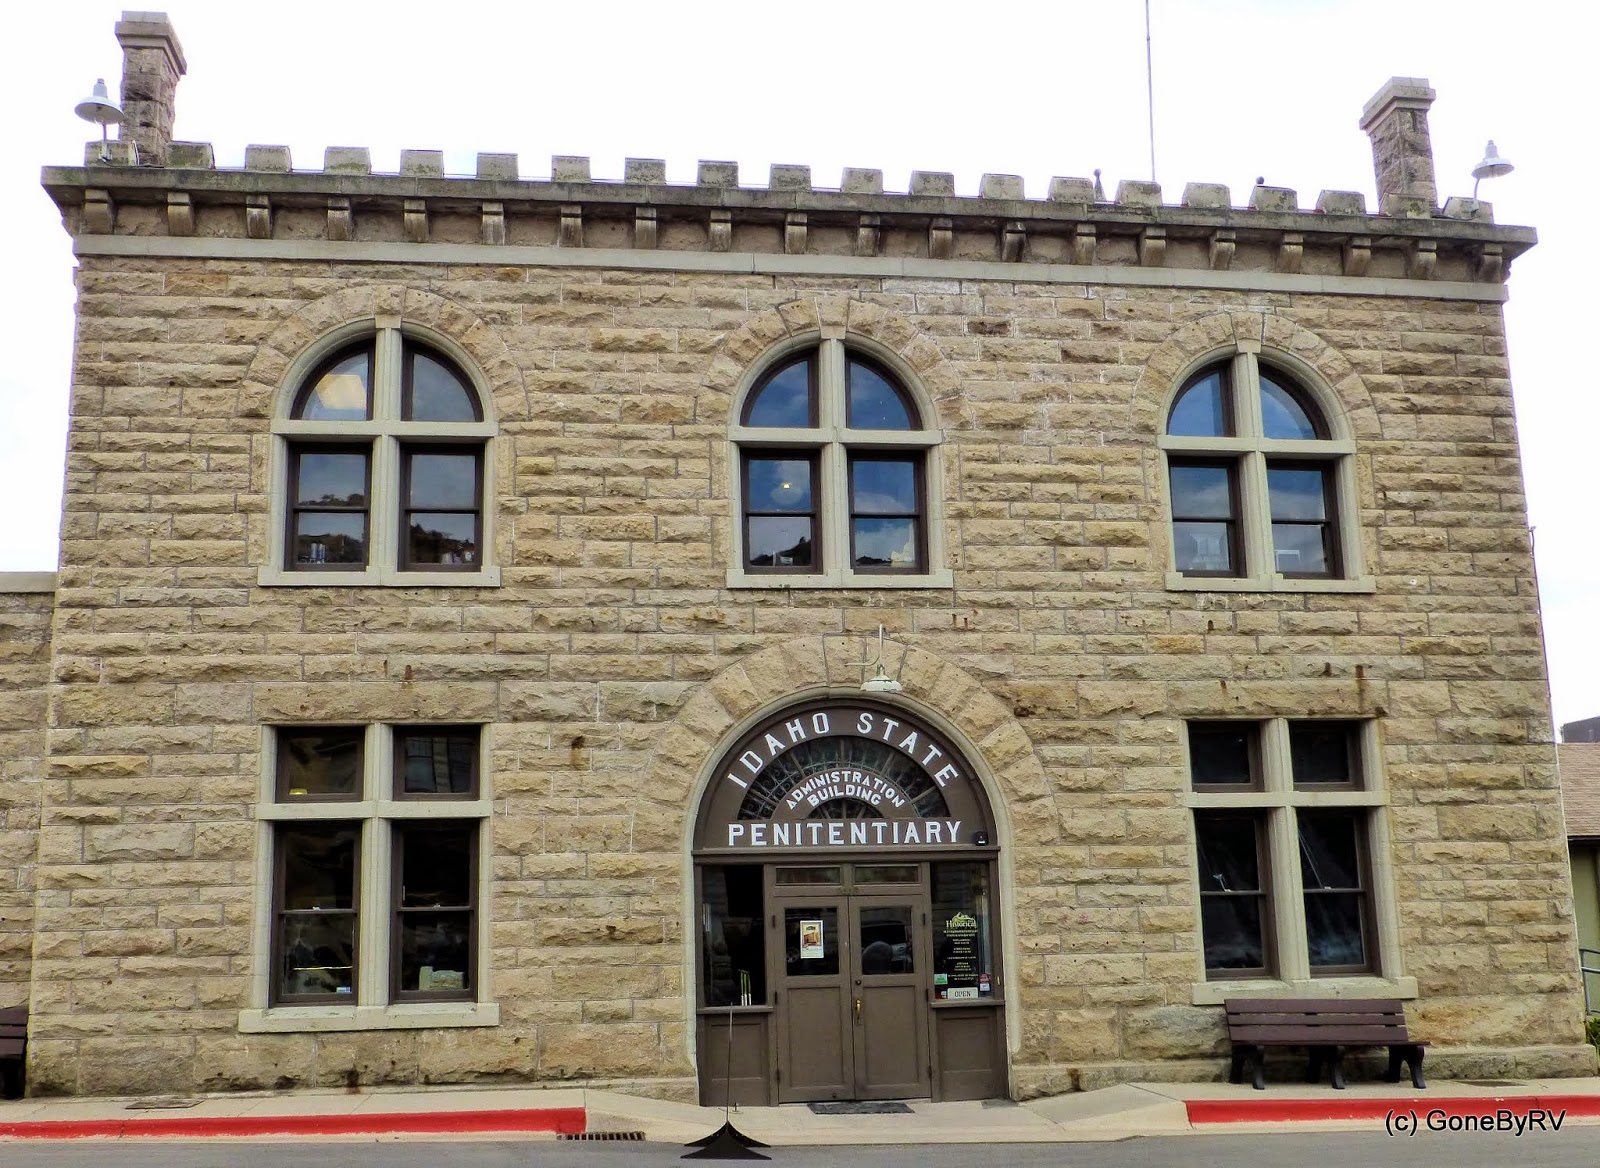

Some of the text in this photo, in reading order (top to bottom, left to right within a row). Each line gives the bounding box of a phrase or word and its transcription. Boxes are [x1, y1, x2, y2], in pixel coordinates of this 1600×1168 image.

[727, 712, 959, 789] IDAHO STATE
[786, 770, 906, 810] ADMINISTRATION
[806, 784, 882, 808] BUILDING
[728, 820, 962, 846] PENITENTIARY
[954, 990, 971, 998] OPEN
